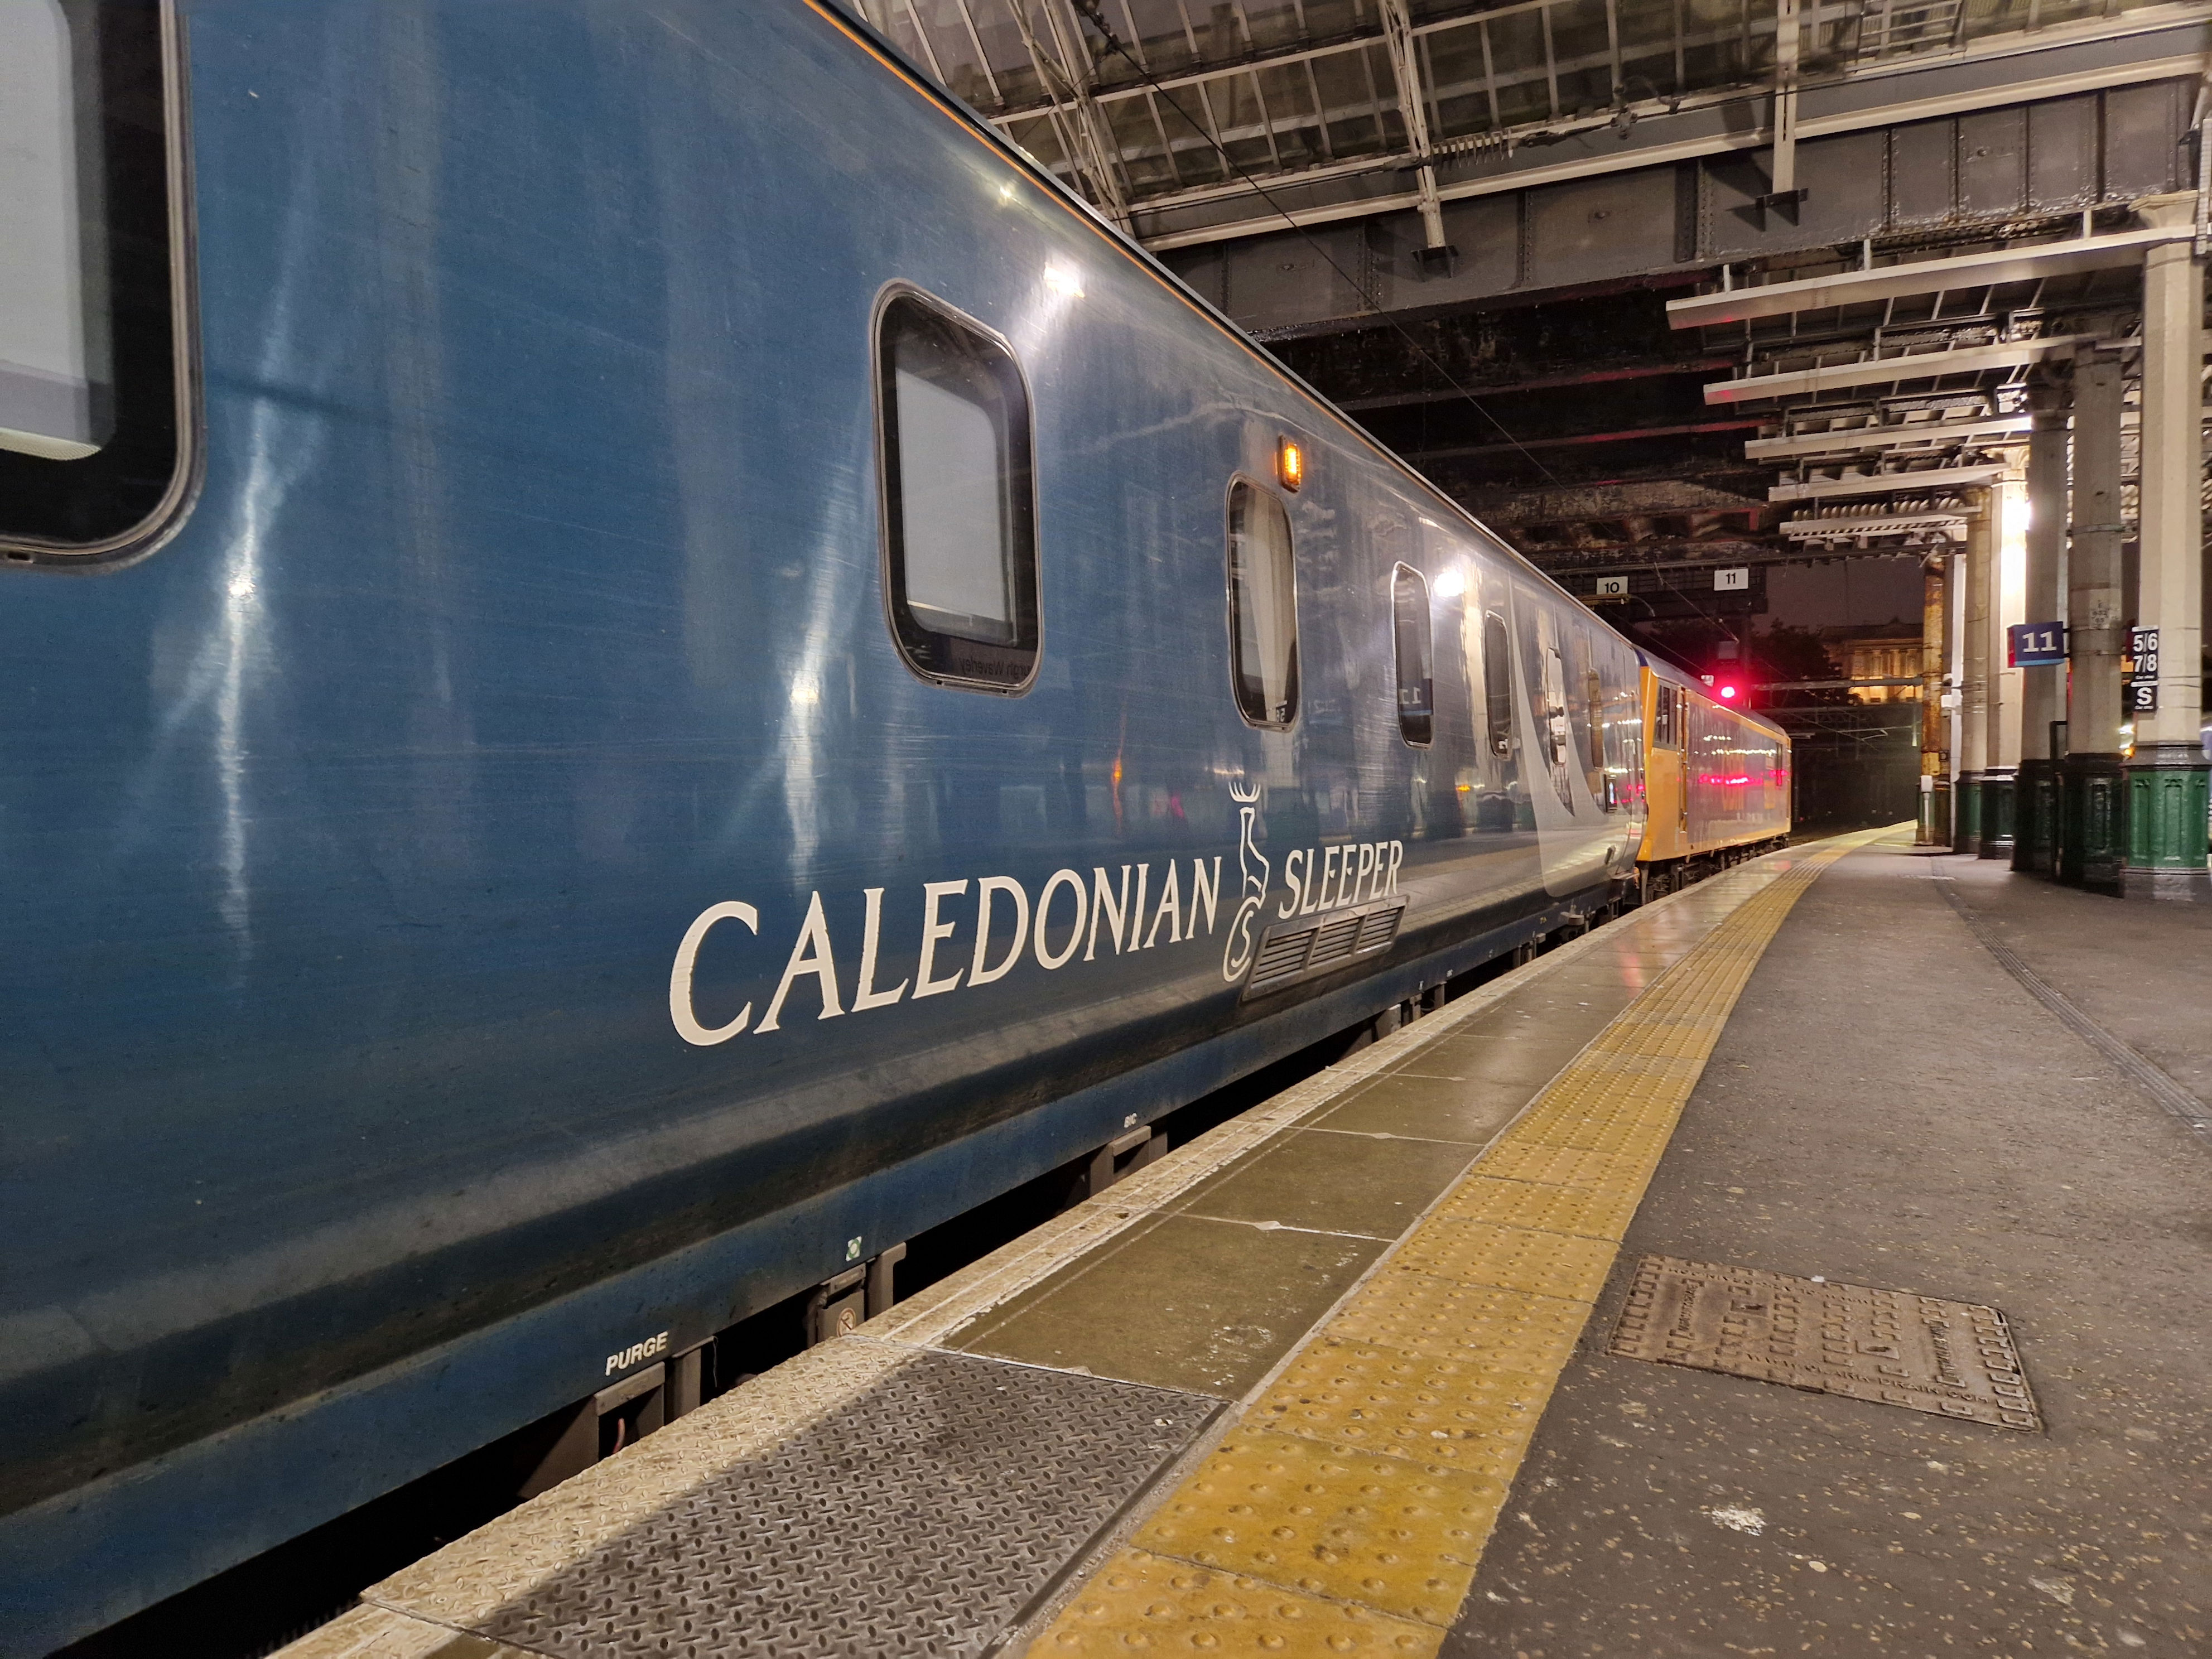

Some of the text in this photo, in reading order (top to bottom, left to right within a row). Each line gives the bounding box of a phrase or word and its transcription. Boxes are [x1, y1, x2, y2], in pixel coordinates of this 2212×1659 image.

[1604, 582, 1620, 593] 10
[1725, 572, 1736, 585] 11
[2022, 631, 2057, 653] 11
[2136, 687, 2152, 705] S
[669, 840, 1404, 1046] CALEDONIAN SLEEPER
[605, 1331, 668, 1377] PURGE
